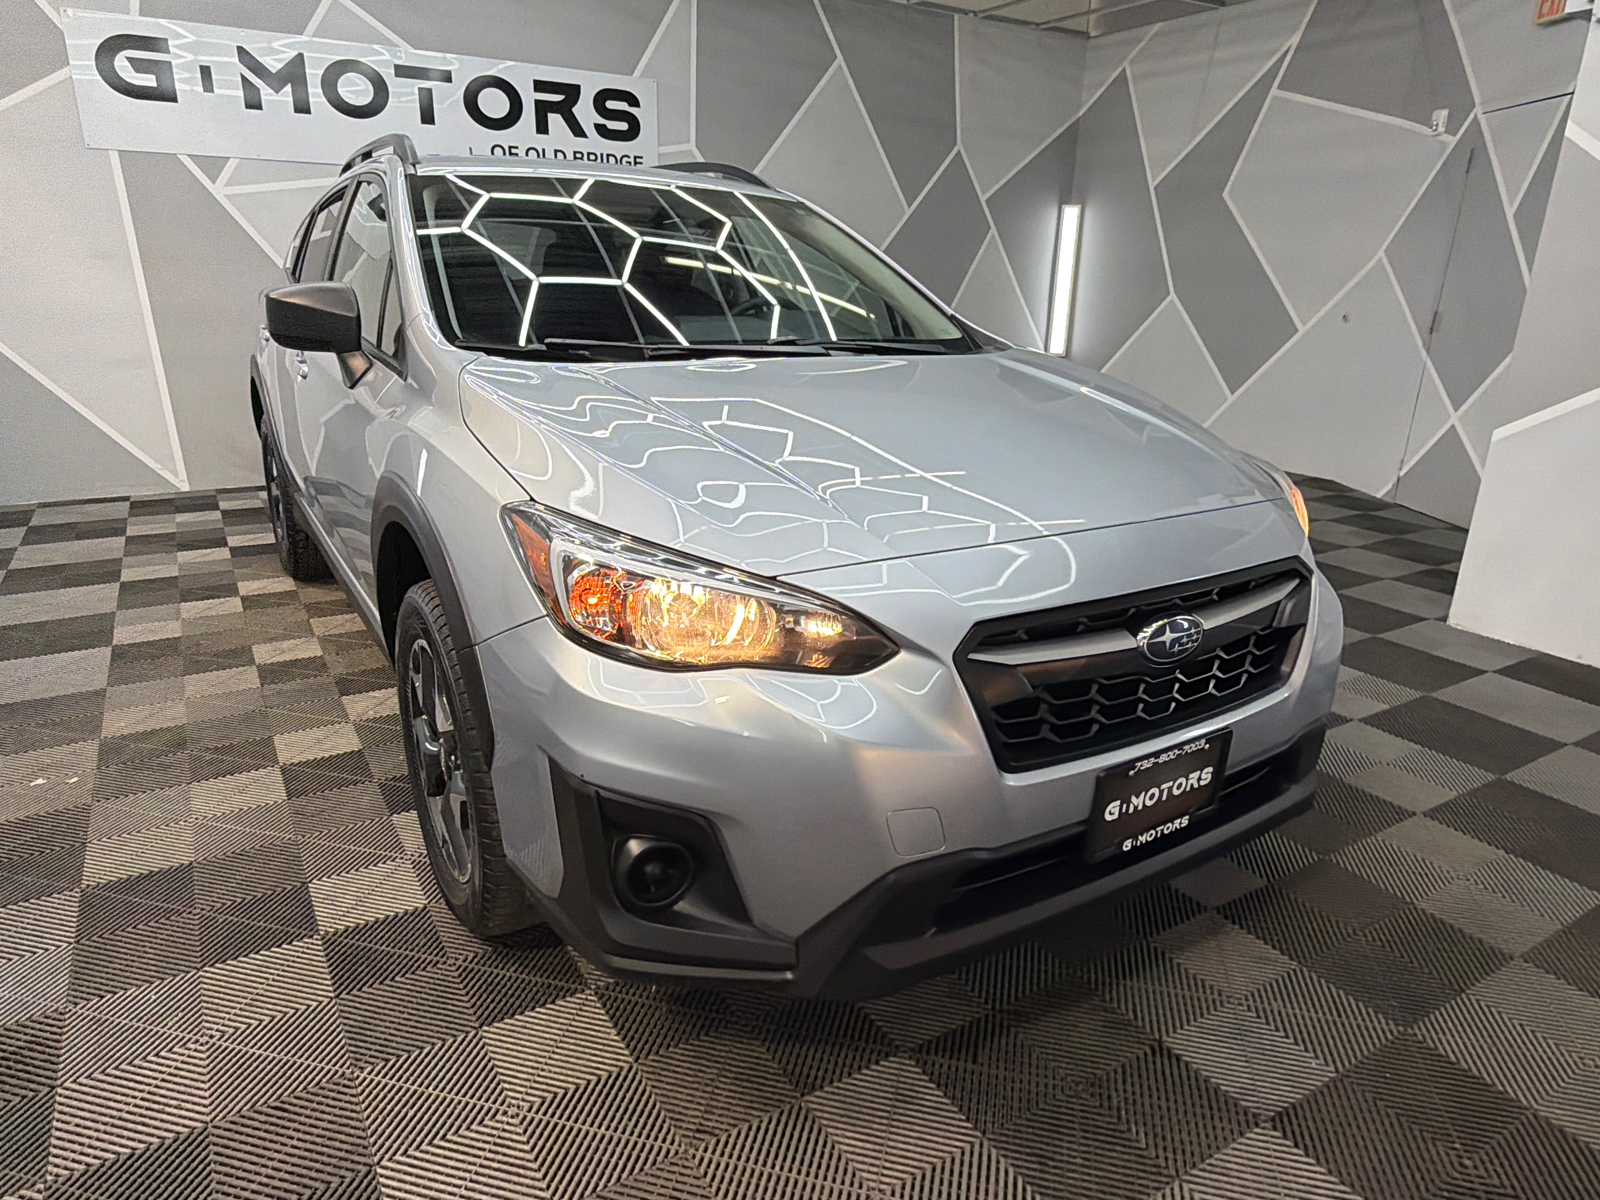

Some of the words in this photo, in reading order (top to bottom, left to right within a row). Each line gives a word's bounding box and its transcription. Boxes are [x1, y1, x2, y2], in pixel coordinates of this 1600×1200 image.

[490, 144, 519, 157] OF
[573, 151, 644, 167] BRIDGE
[1134, 739, 1206, 772] 732-800-7003
